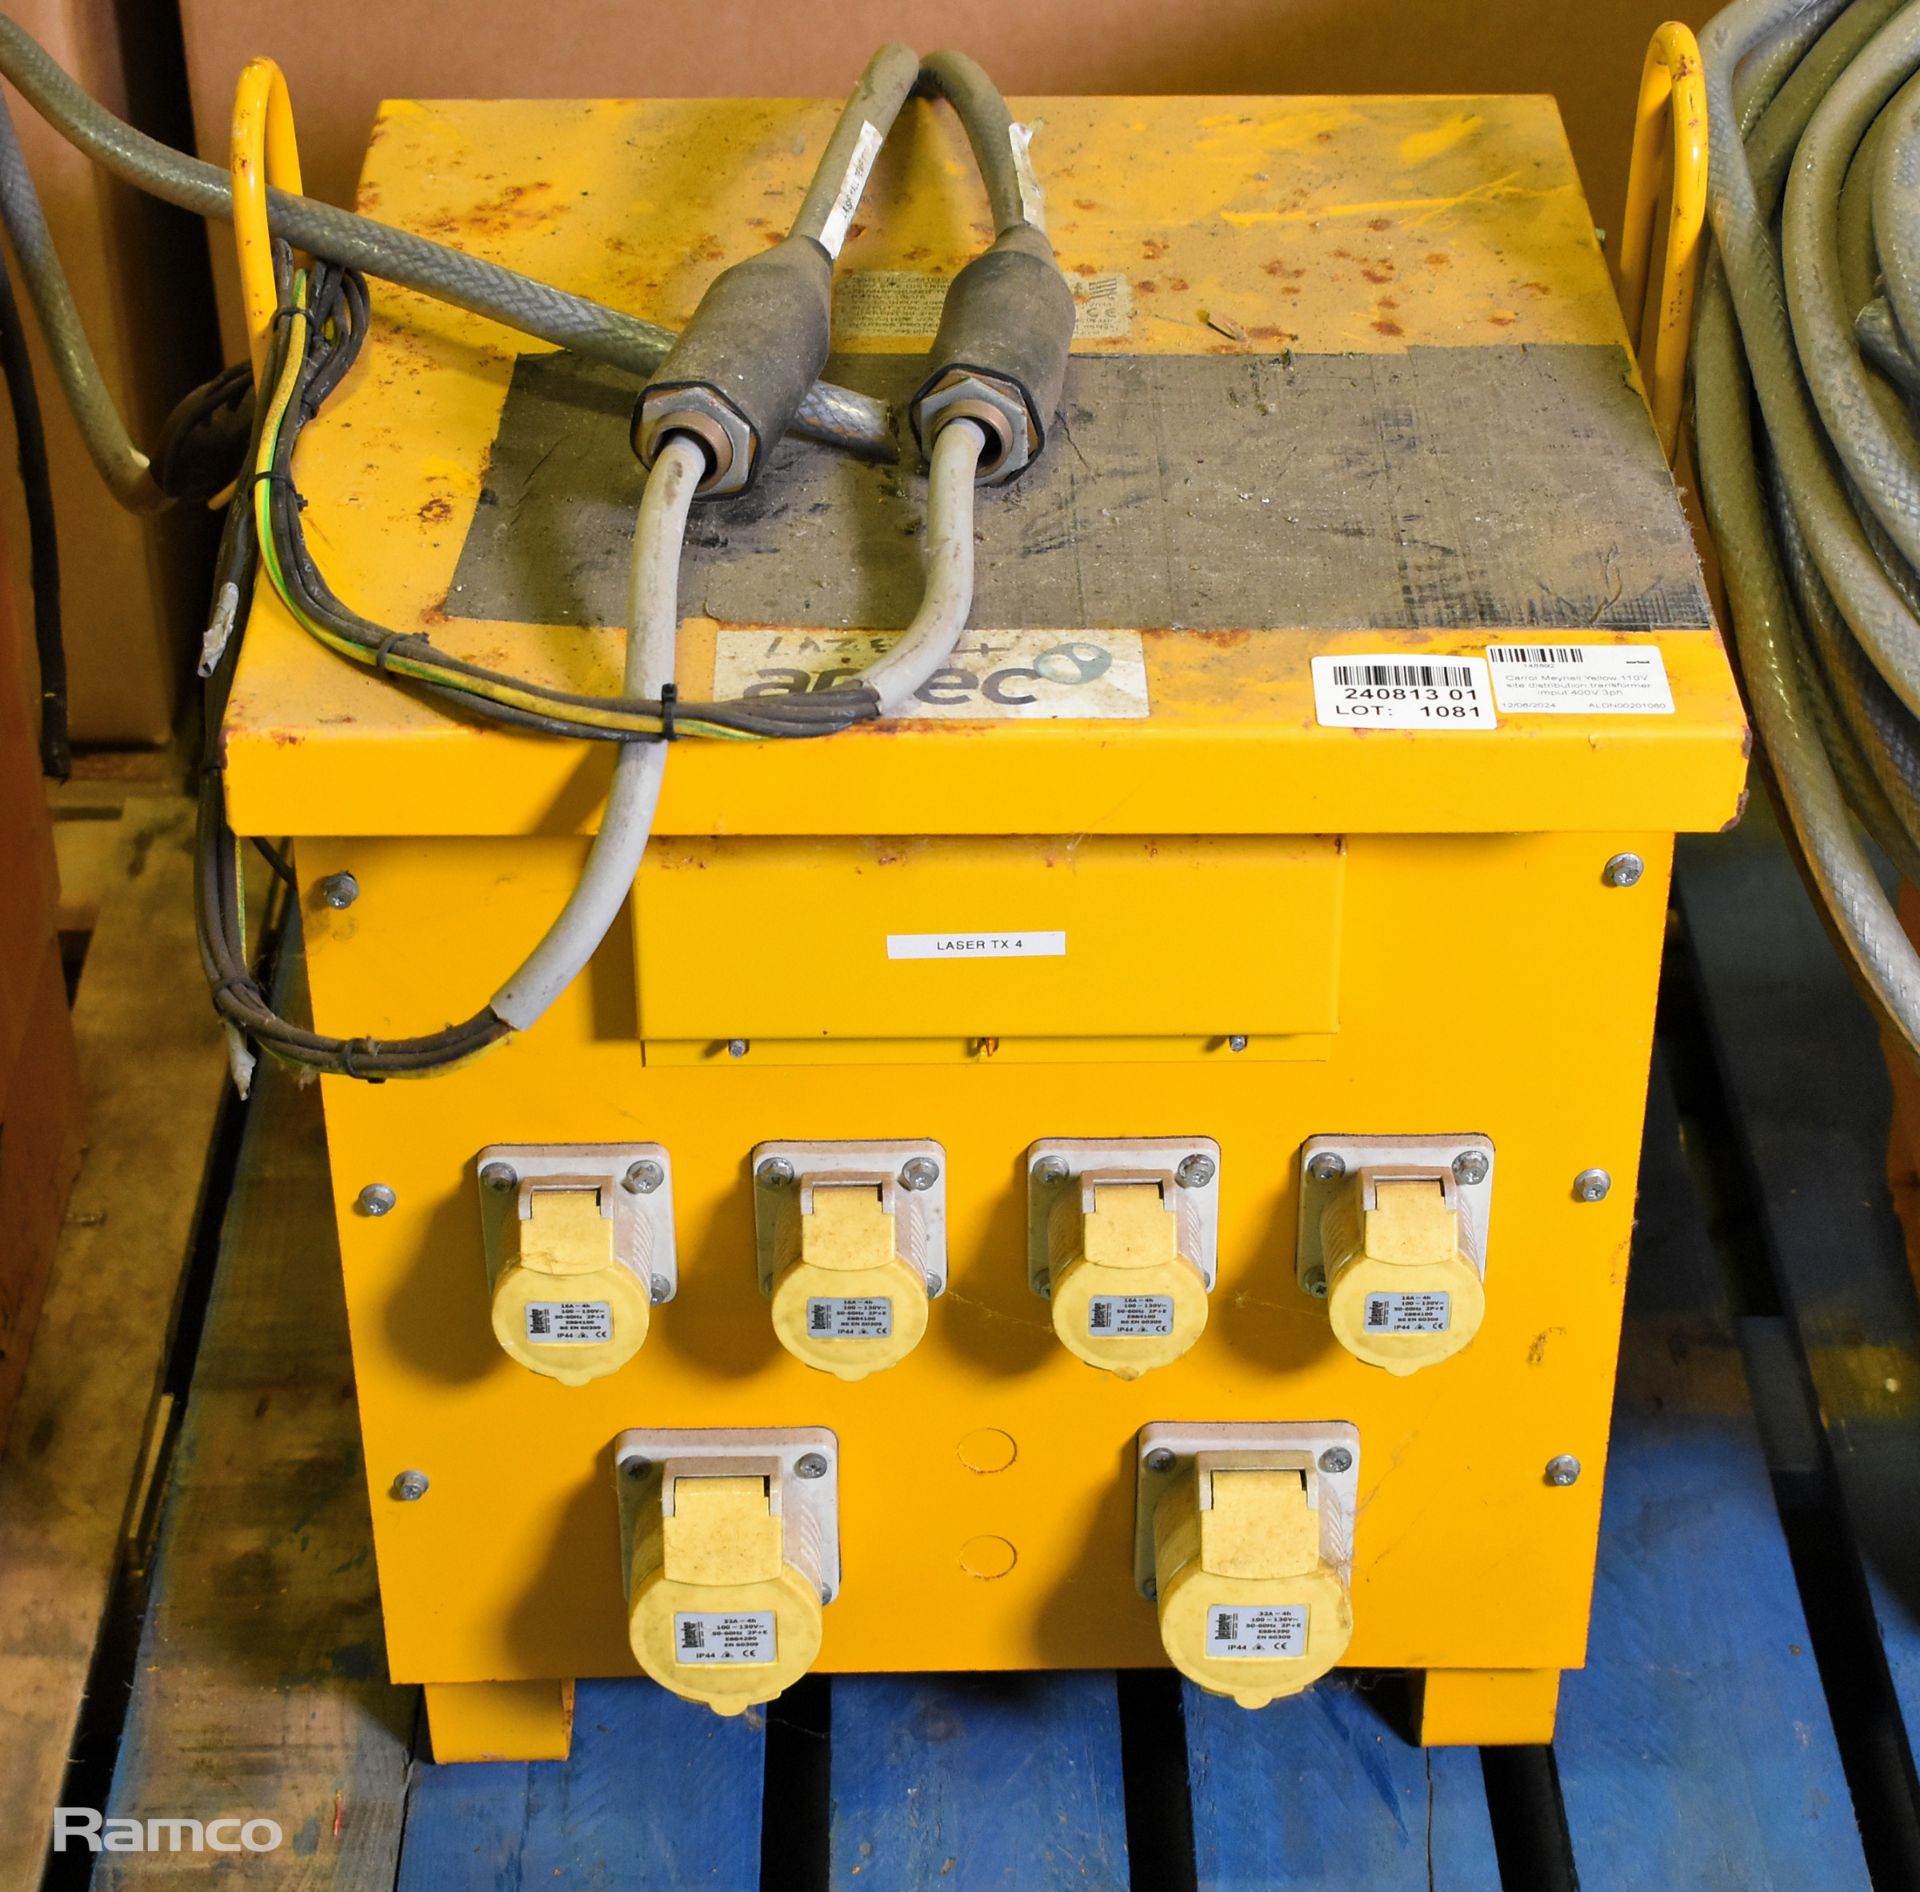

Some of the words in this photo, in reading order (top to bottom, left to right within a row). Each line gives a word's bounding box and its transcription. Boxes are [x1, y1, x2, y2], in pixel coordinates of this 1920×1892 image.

[1345, 689, 1438, 700] 240813
[1450, 690, 1477, 700] 01
[1336, 705, 1392, 715] LOT:
[1420, 706, 1480, 717] 1081
[937, 941, 985, 950] LASER
[992, 940, 1008, 948] TX
[1016, 940, 1022, 948] 4
